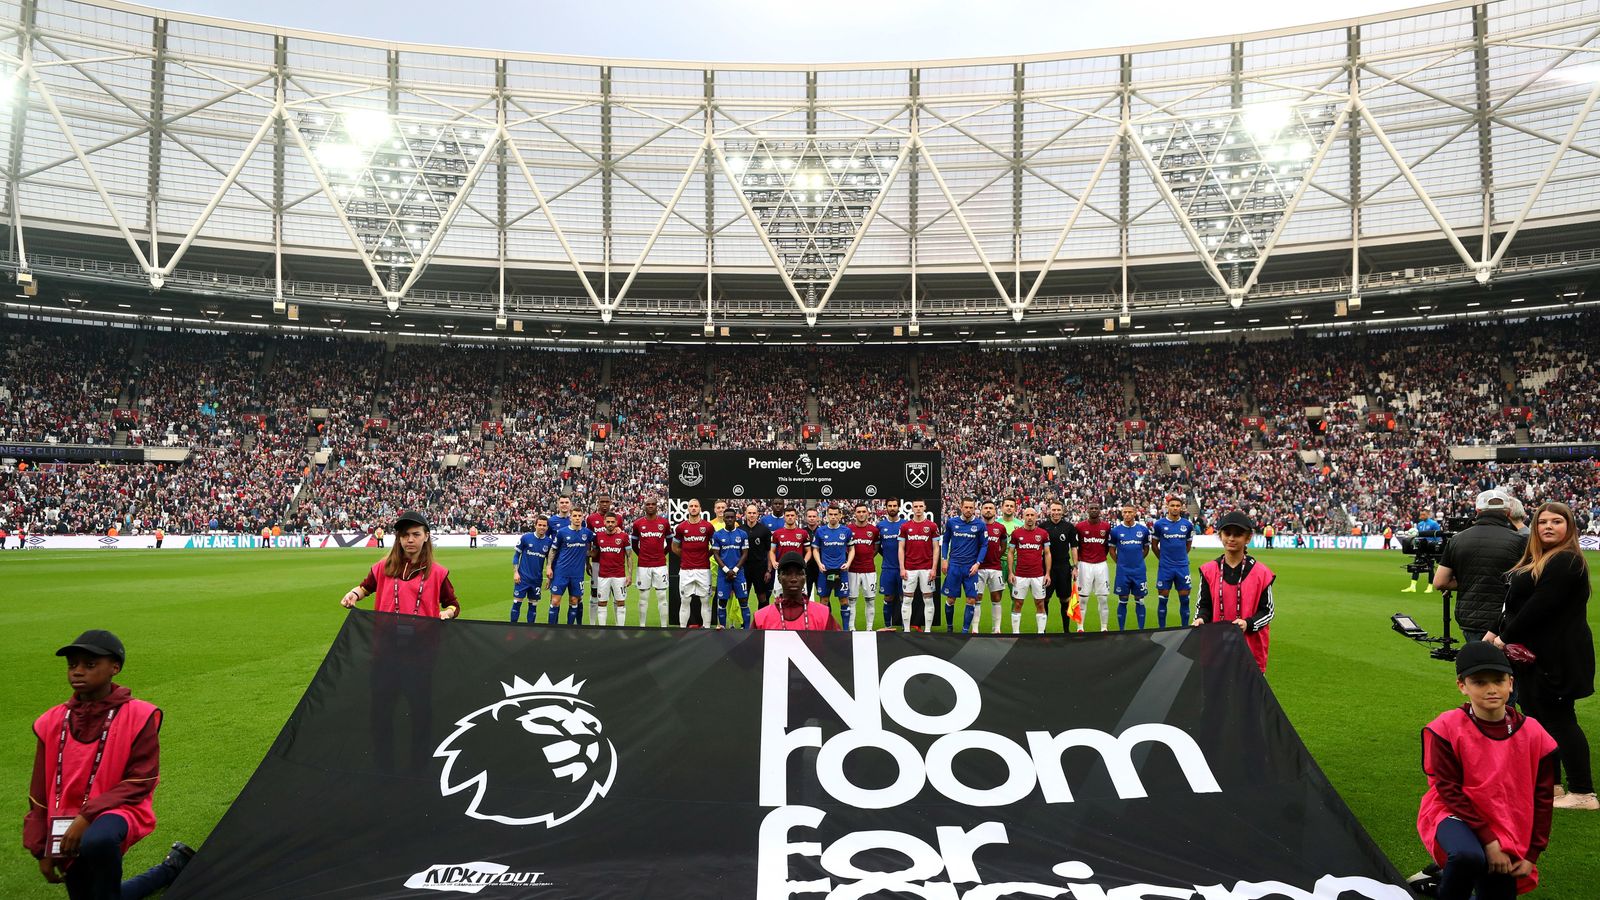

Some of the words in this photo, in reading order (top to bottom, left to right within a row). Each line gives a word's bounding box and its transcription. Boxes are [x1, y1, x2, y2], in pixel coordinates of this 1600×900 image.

[748, 457, 793, 469] Premier
[816, 458, 861, 472] League
[640, 531, 663, 539] betway
[907, 534, 930, 542] betway
[191, 535, 211, 547] WE
[211, 535, 236, 547] ARE
[238, 535, 252, 547] IN
[254, 535, 276, 547] TE
[278, 535, 302, 547] GYM
[779, 540, 802, 548] betway
[1083, 536, 1106, 545] betway
[1272, 536, 1296, 548] ARE
[1313, 535, 1335, 548] THE
[1337, 535, 1363, 548] GYM
[599, 546, 622, 554] betway
[1018, 542, 1041, 551] betway
[840, 582, 849, 591] 23
[761, 631, 982, 735] No
[759, 722, 1223, 809] room
[757, 805, 1010, 886] for
[424, 866, 478, 884] KICK
[475, 872, 498, 884] IT
[498, 872, 545, 884] OUT
